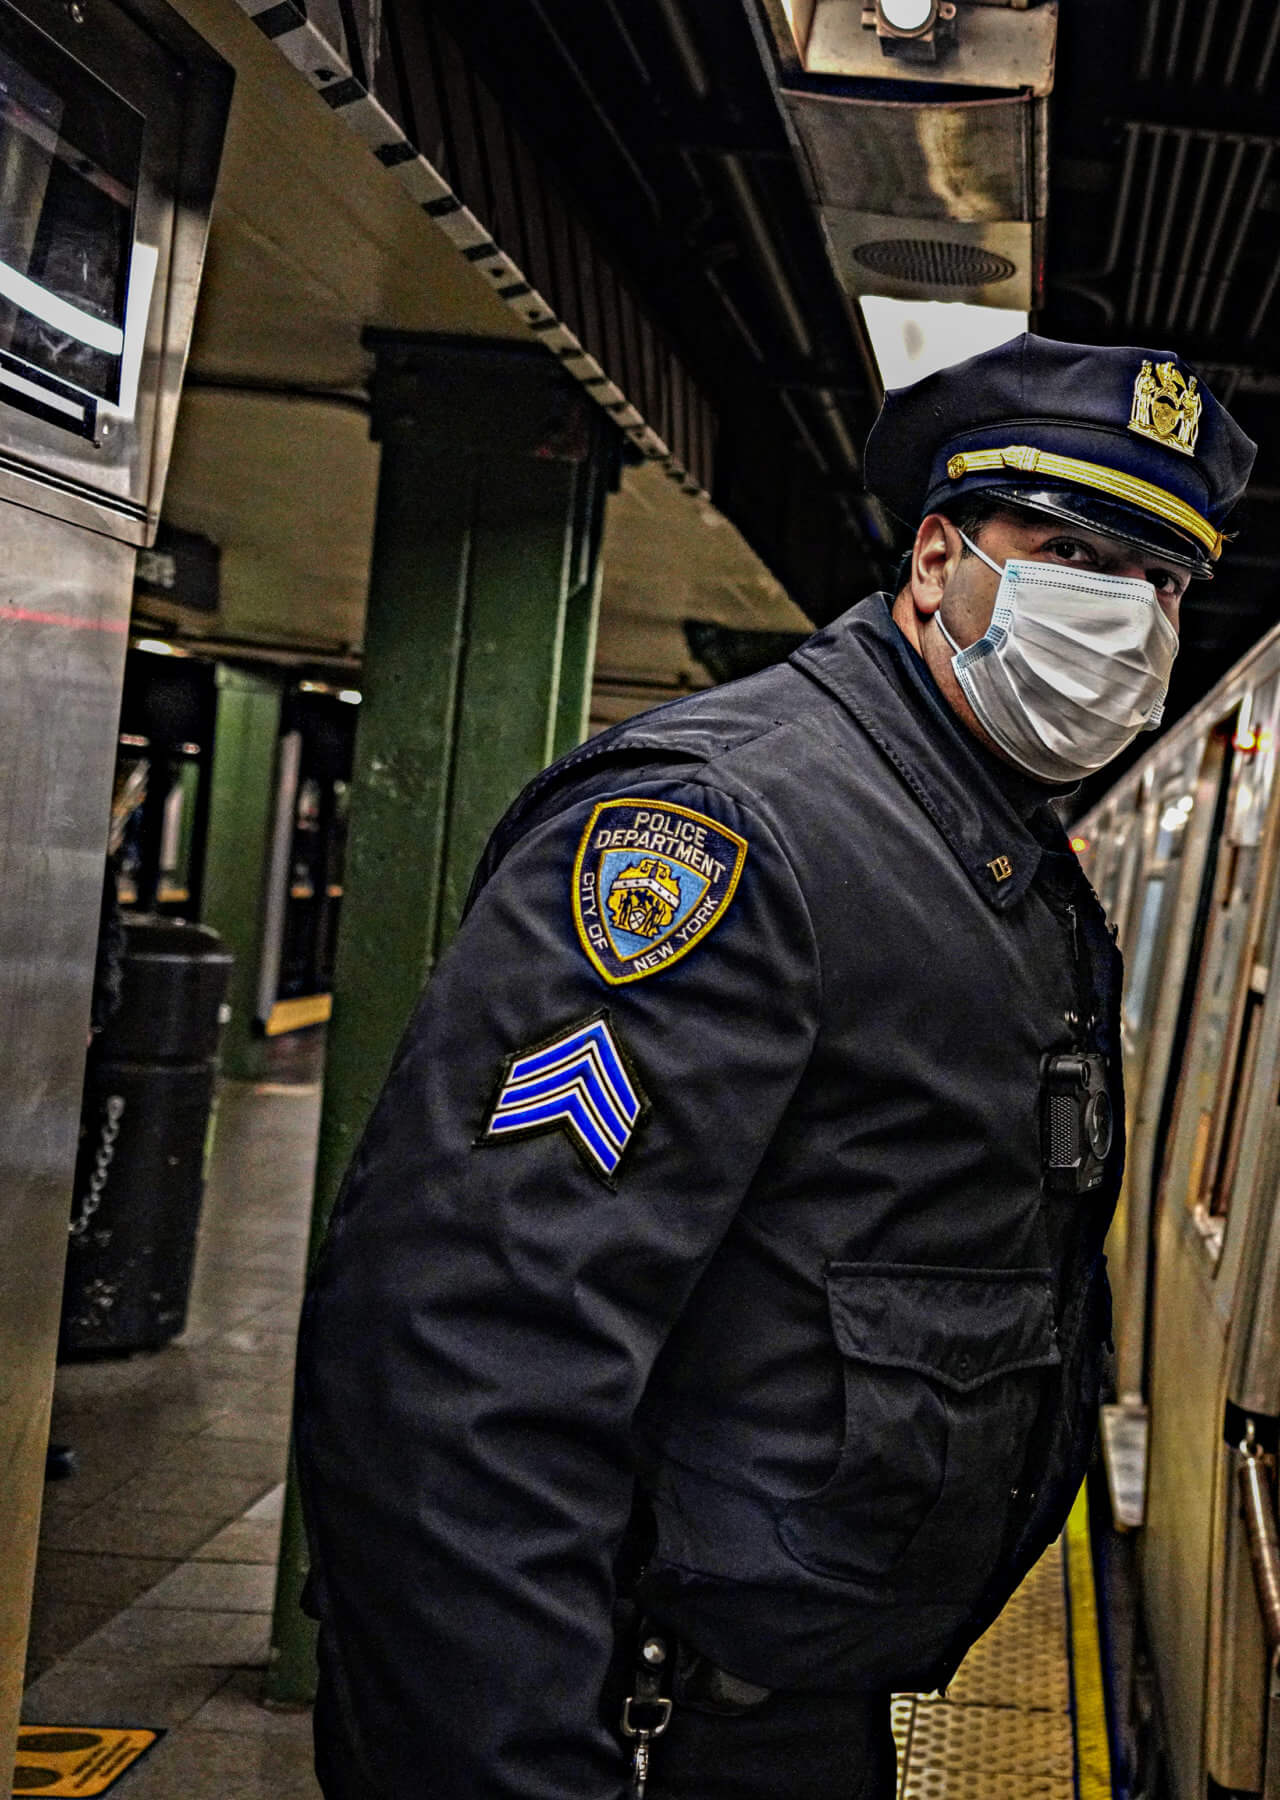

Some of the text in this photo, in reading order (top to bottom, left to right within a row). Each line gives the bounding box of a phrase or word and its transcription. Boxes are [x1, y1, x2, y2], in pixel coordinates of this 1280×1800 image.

[634, 811, 708, 848] POLICE
[594, 830, 726, 884] DEPARTMENT
[581, 872, 719, 973] CITY OF NEW YORK
